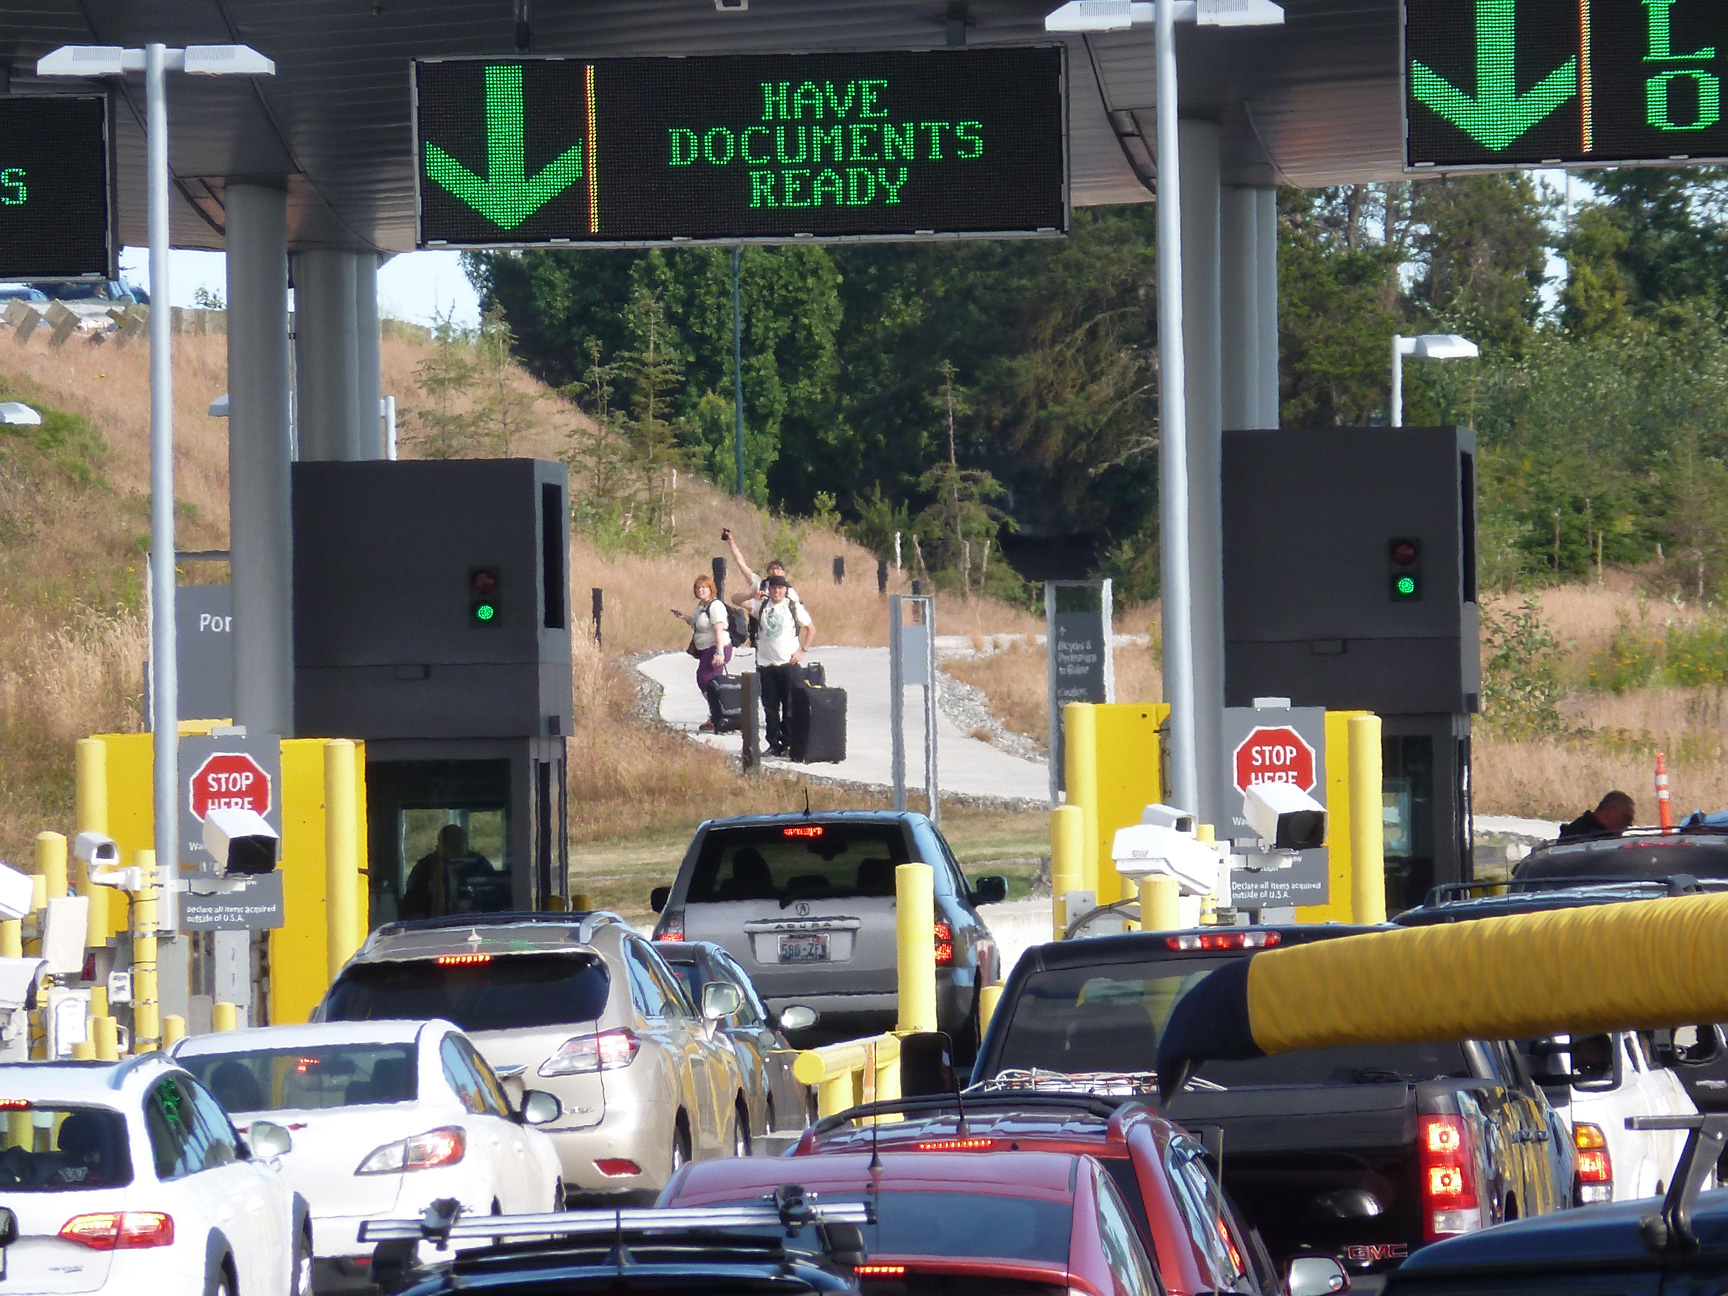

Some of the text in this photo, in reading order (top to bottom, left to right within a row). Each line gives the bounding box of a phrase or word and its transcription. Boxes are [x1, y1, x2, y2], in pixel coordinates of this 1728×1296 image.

[760, 79, 888, 121] HAVE
[668, 120, 985, 166] DOCUMENTS
[749, 166, 908, 209] READY
[1251, 744, 1297, 766] STOP
[208, 771, 254, 792] STOP
[1232, 881, 1322, 891] Declare all items acquired
[1232, 890, 1291, 899] outside of U.S.A.
[187, 903, 276, 915] Declare all items acquired
[187, 914, 213, 923] outside
[214, 914, 222, 922] of
[1347, 1243, 1408, 1260] GMC
